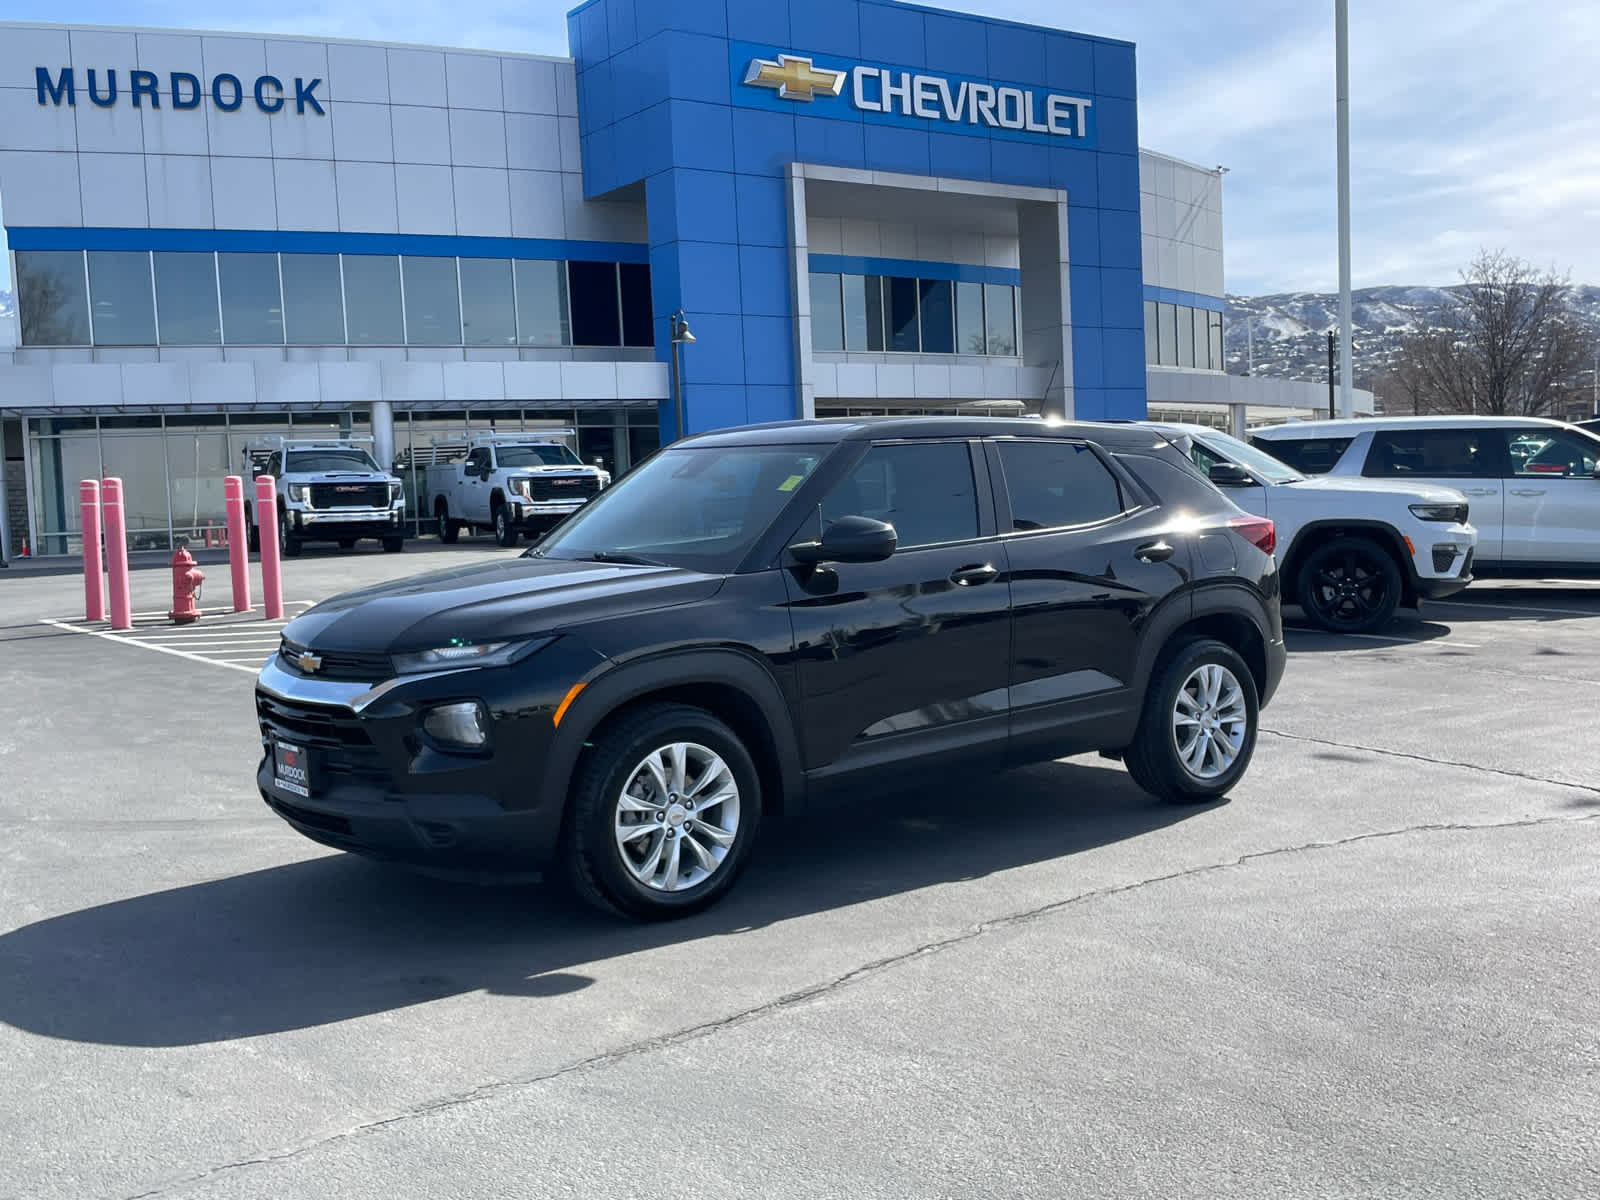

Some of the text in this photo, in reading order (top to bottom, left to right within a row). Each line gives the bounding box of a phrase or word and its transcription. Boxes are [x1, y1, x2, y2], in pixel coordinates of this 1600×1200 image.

[35, 66, 325, 116] MURDOCK
[853, 65, 1092, 137] CHEVROLET
[278, 762, 306, 781] MURDOCK
